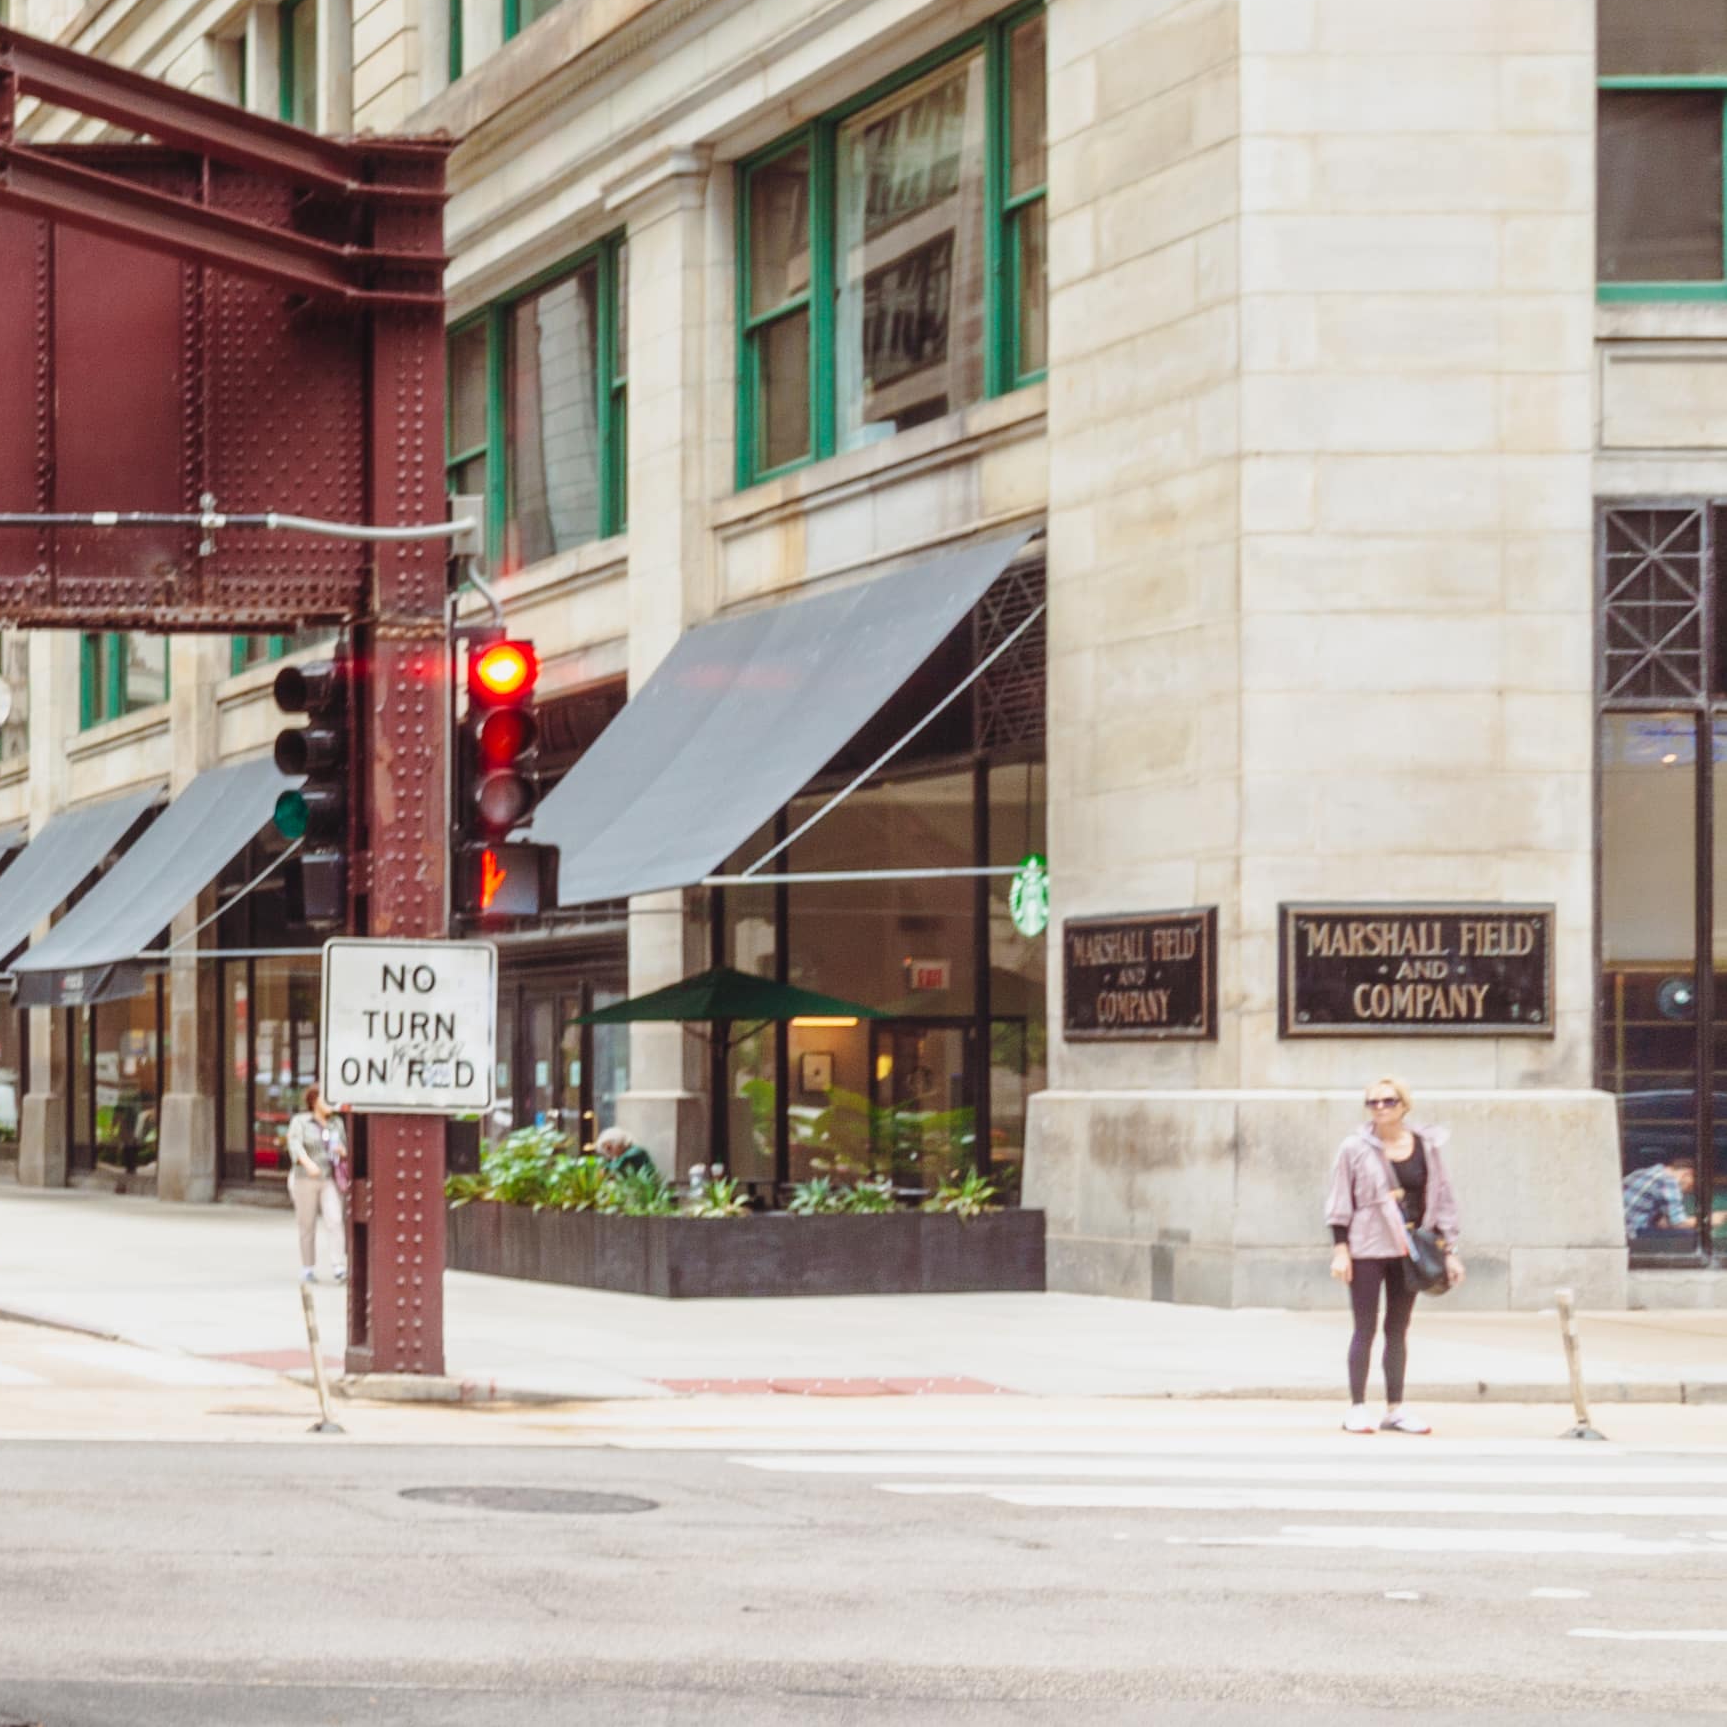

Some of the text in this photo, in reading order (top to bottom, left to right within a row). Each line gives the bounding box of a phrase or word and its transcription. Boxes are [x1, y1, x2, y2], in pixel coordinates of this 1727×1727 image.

[1072, 926, 1197, 966] MARSHALL FIELD
[1306, 921, 1534, 957] MARSHALL FIELD
[381, 963, 437, 994] NO
[1395, 960, 1449, 980] AND
[1097, 989, 1172, 1023] COMPANY
[1352, 983, 1491, 1019] COMPANY
[362, 1010, 456, 1041] TURN
[341, 1057, 388, 1086] ON
